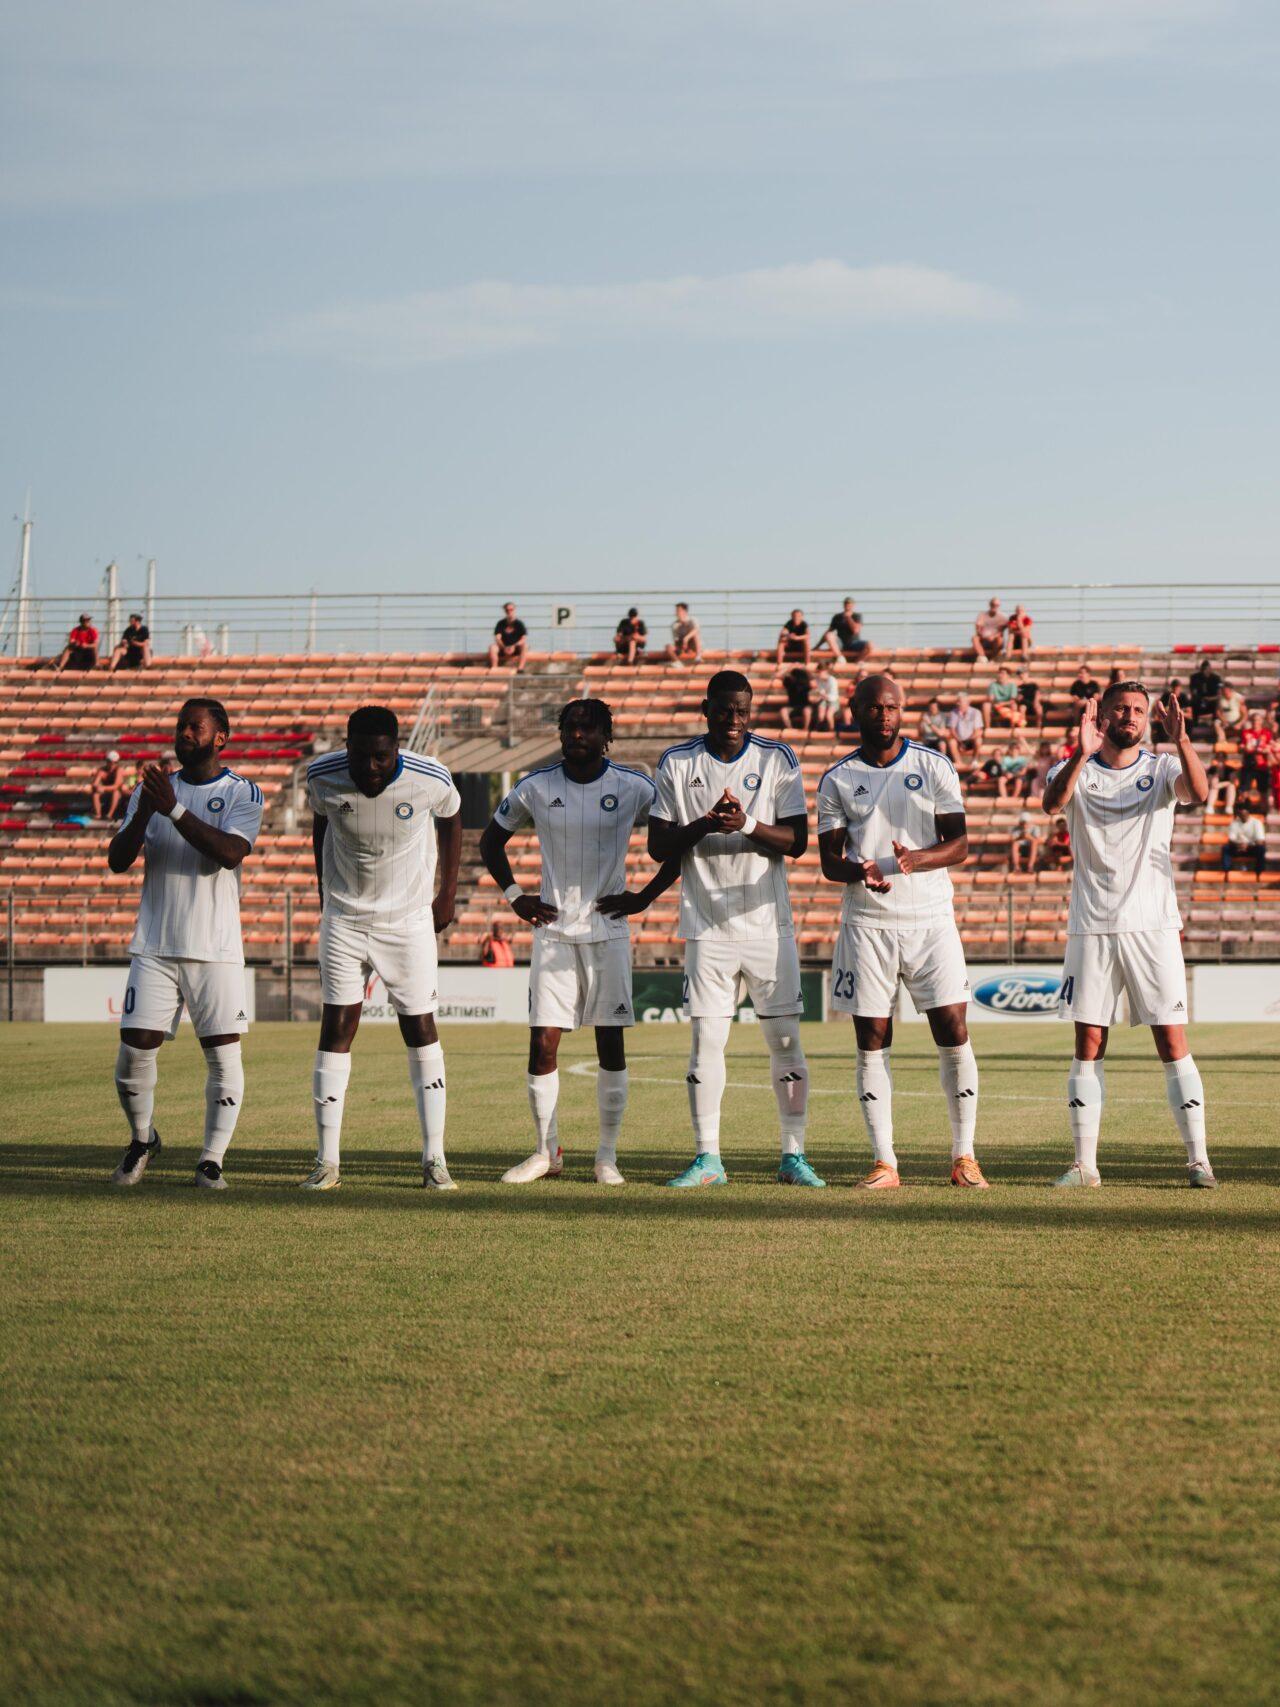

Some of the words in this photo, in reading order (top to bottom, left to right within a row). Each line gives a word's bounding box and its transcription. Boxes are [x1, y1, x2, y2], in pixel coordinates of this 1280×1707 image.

[557, 608, 571, 624] P
[833, 968, 855, 999] 23
[992, 977, 1061, 1010] Ford
